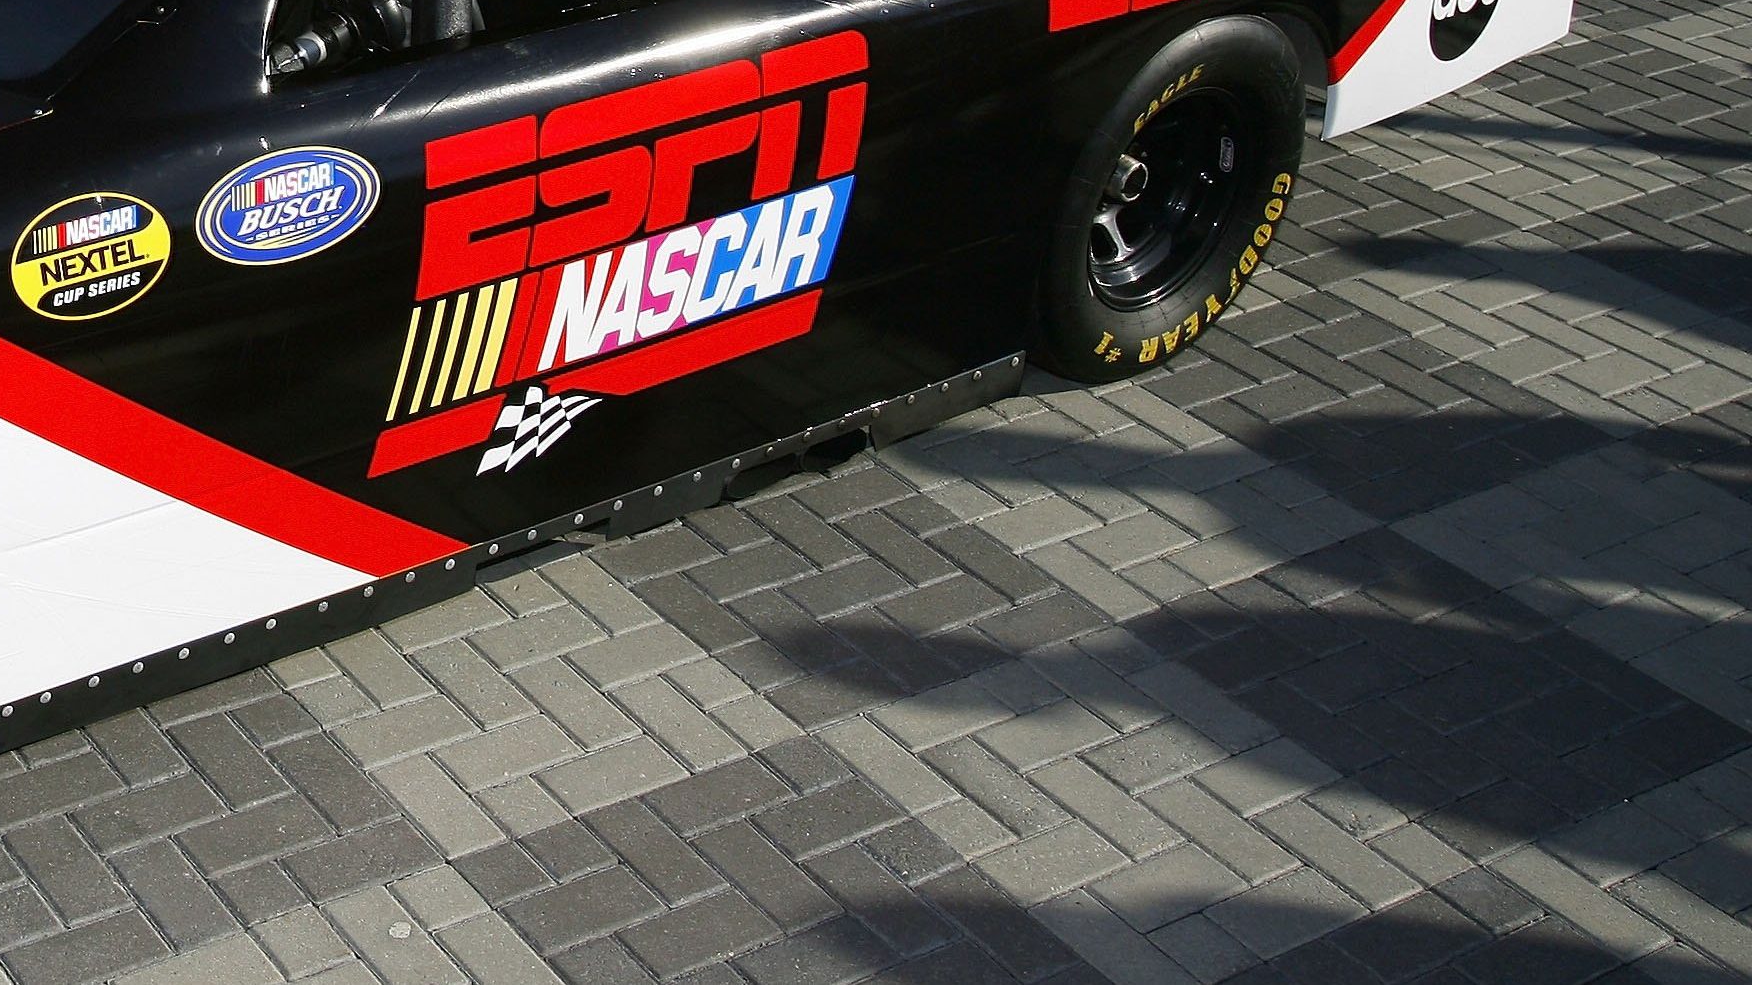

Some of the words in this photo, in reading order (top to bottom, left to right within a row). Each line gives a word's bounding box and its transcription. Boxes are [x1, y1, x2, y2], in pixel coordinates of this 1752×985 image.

[1133, 64, 1205, 135] EAGLE
[263, 162, 332, 204] NASCAR
[415, 29, 869, 301] ESPN
[64, 205, 136, 245] NASCAR
[237, 185, 345, 237] BUSCH
[39, 244, 146, 287] NEXTEL
[537, 183, 836, 373] NASCAR
[53, 287, 85, 308] CUP
[87, 271, 141, 298] SERIES
[1093, 331, 1122, 363] #1
